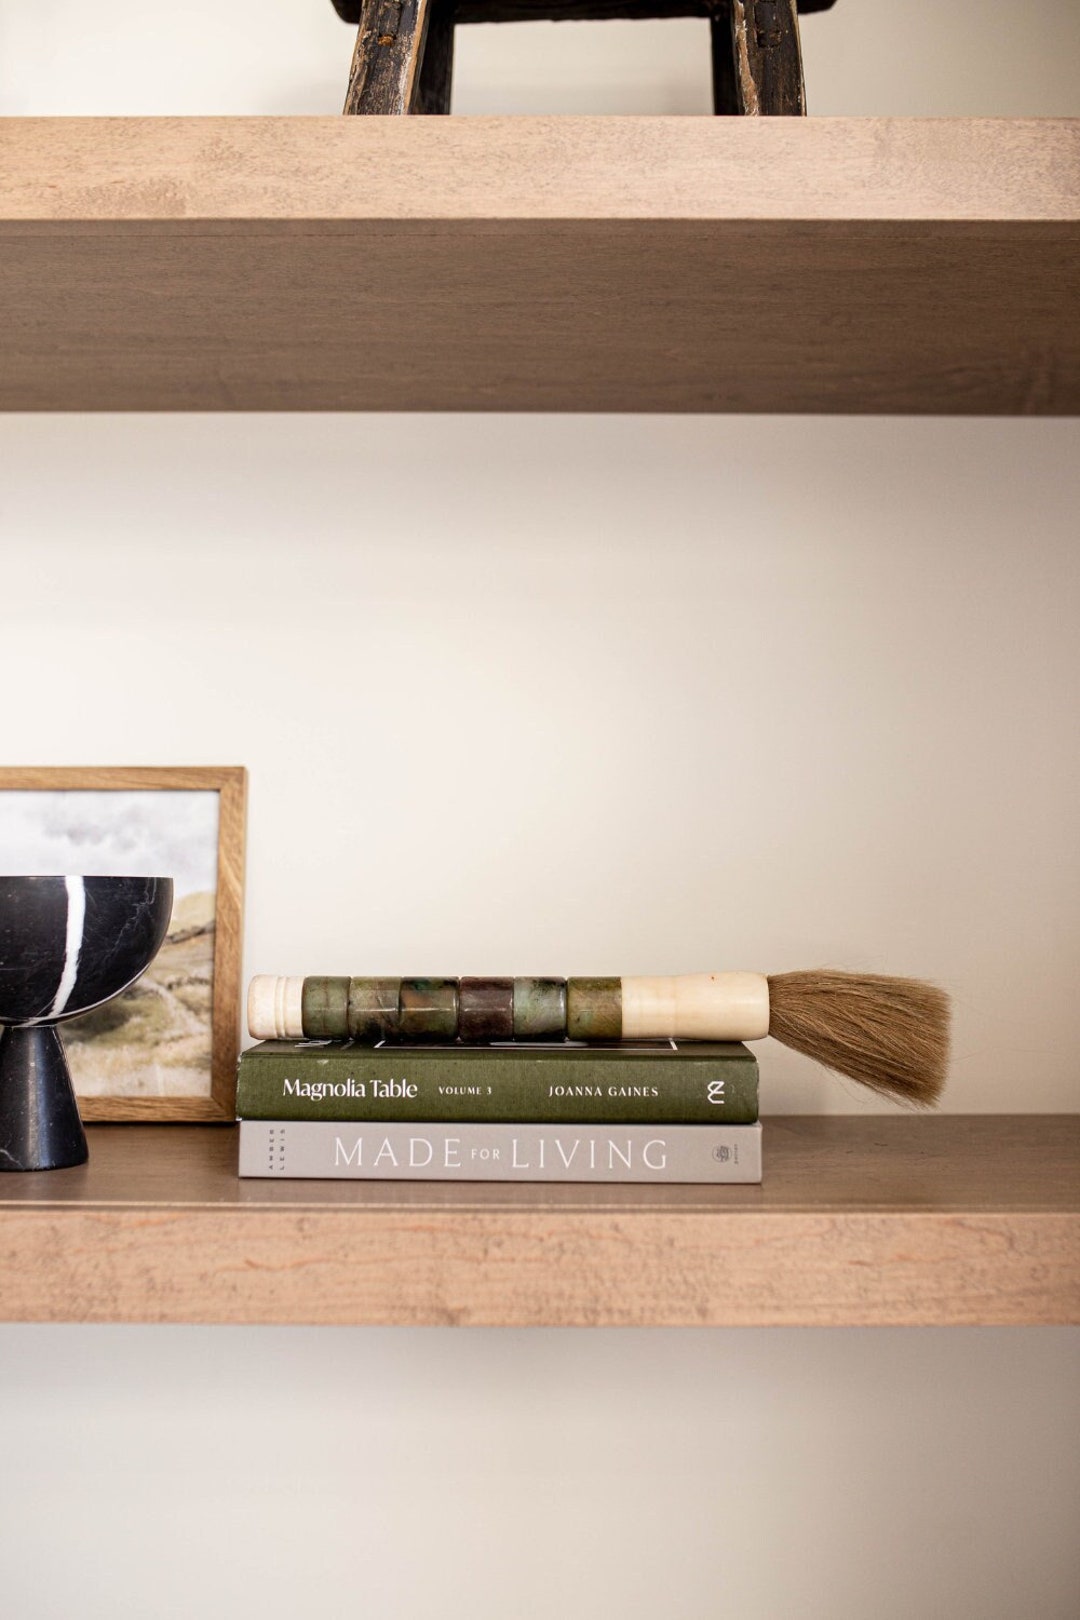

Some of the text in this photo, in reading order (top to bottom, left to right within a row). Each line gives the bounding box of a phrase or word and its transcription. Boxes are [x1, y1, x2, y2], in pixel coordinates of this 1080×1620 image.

[283, 1078, 659, 1101] Magnolia Table VOLUME 3 JOANNA GAINES
[334, 1136, 668, 1170] MADE FOR LIVING
